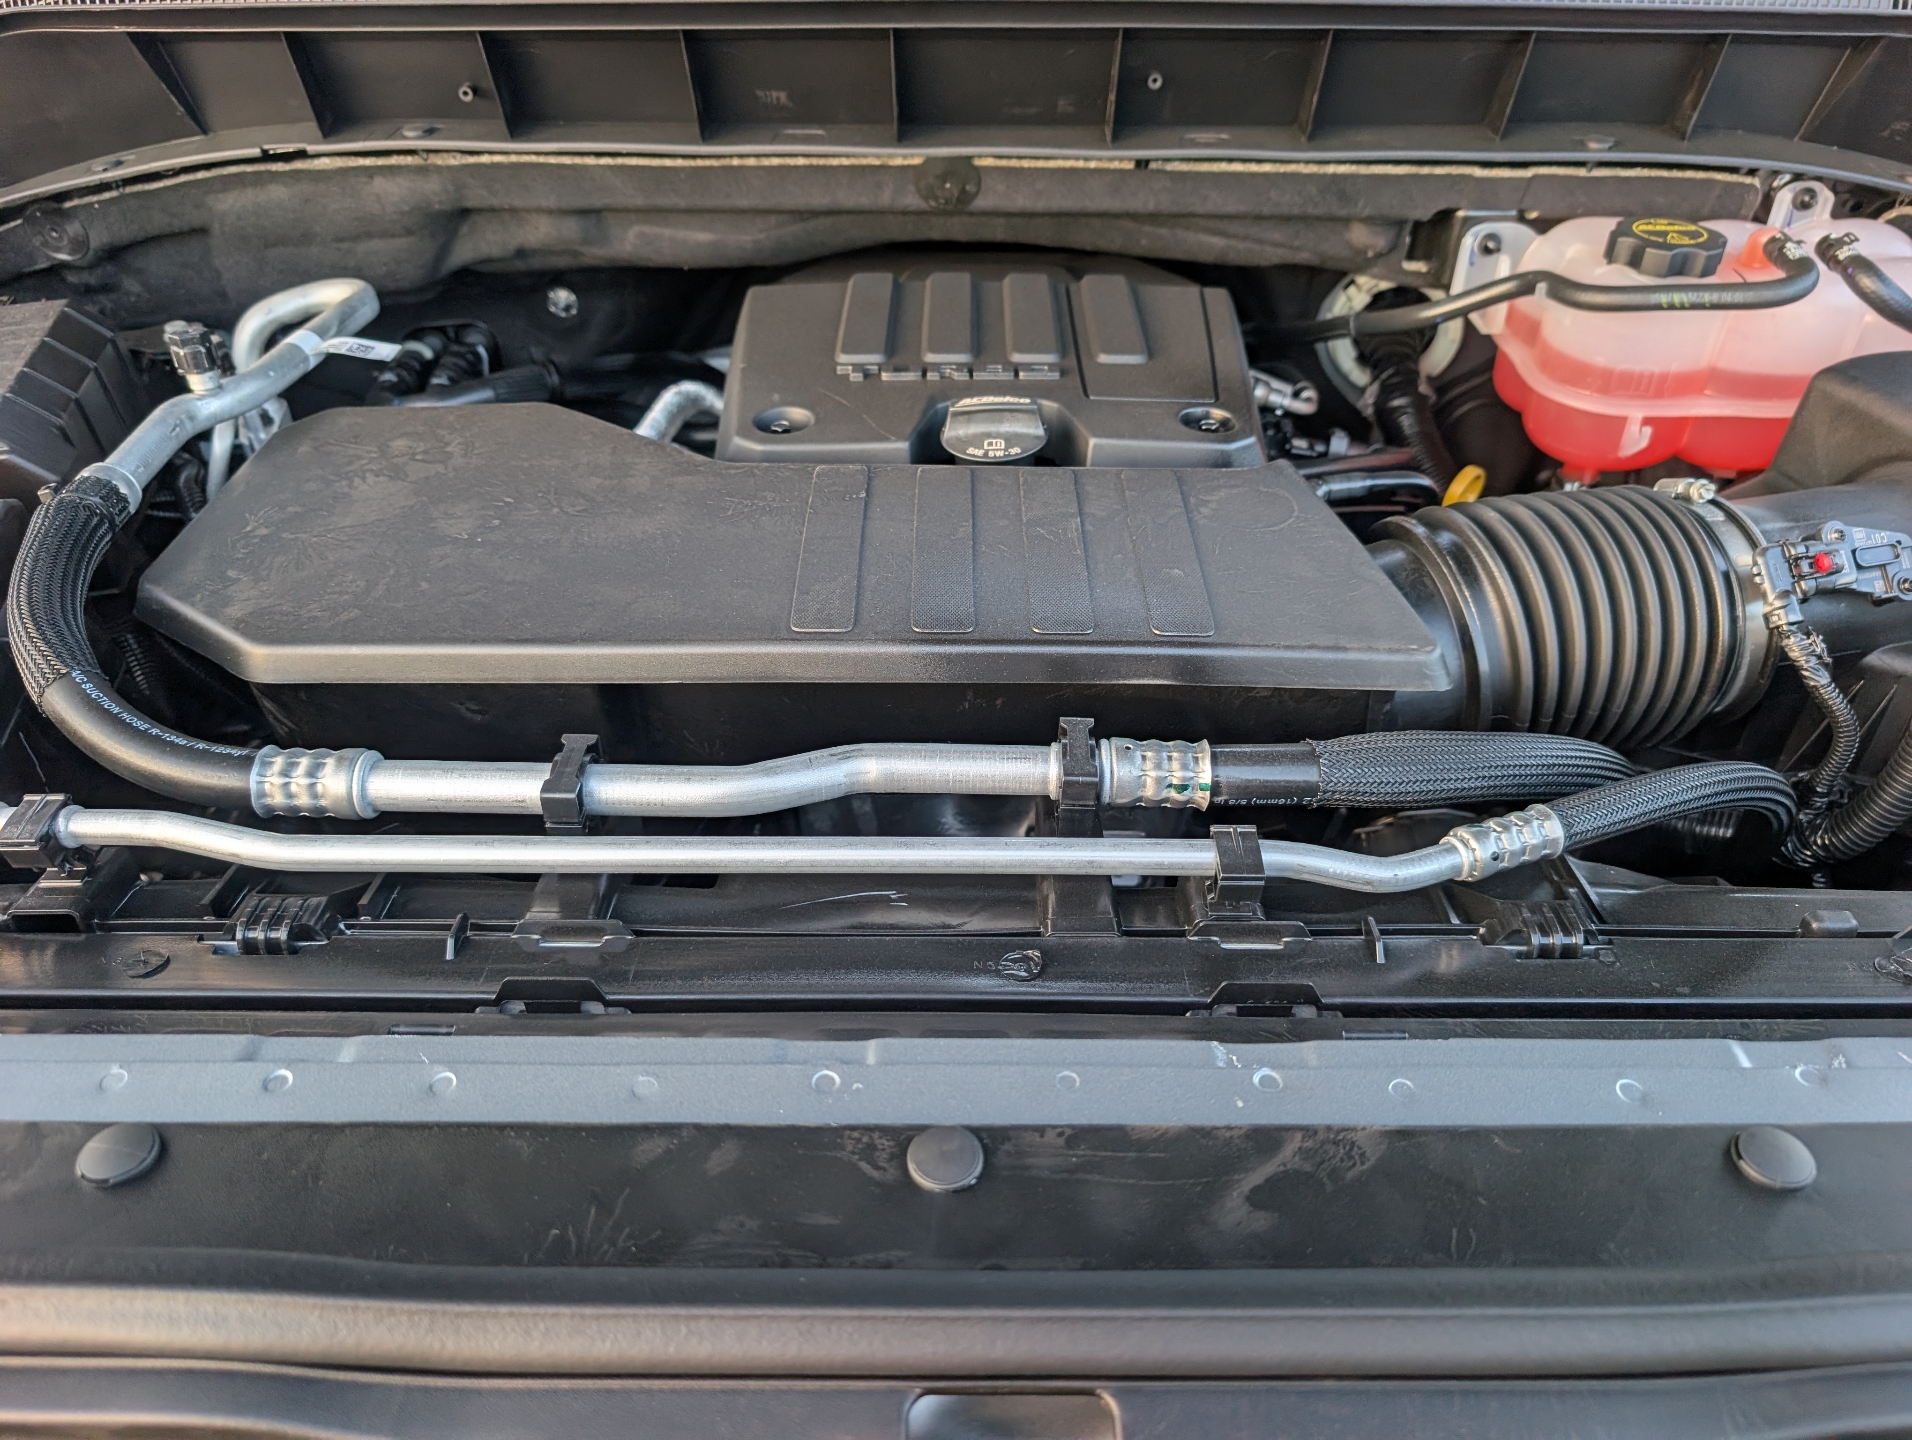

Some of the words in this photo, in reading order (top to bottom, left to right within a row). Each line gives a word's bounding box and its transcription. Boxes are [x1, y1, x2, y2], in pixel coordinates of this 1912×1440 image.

[965, 446, 985, 457] SAE
[988, 446, 1022, 458] 5W-30
[70, 669, 88, 683] A/C
[81, 683, 124, 714] SUCTION
[118, 712, 151, 731] HOSE
[1250, 796, 1298, 806] (16mm)
